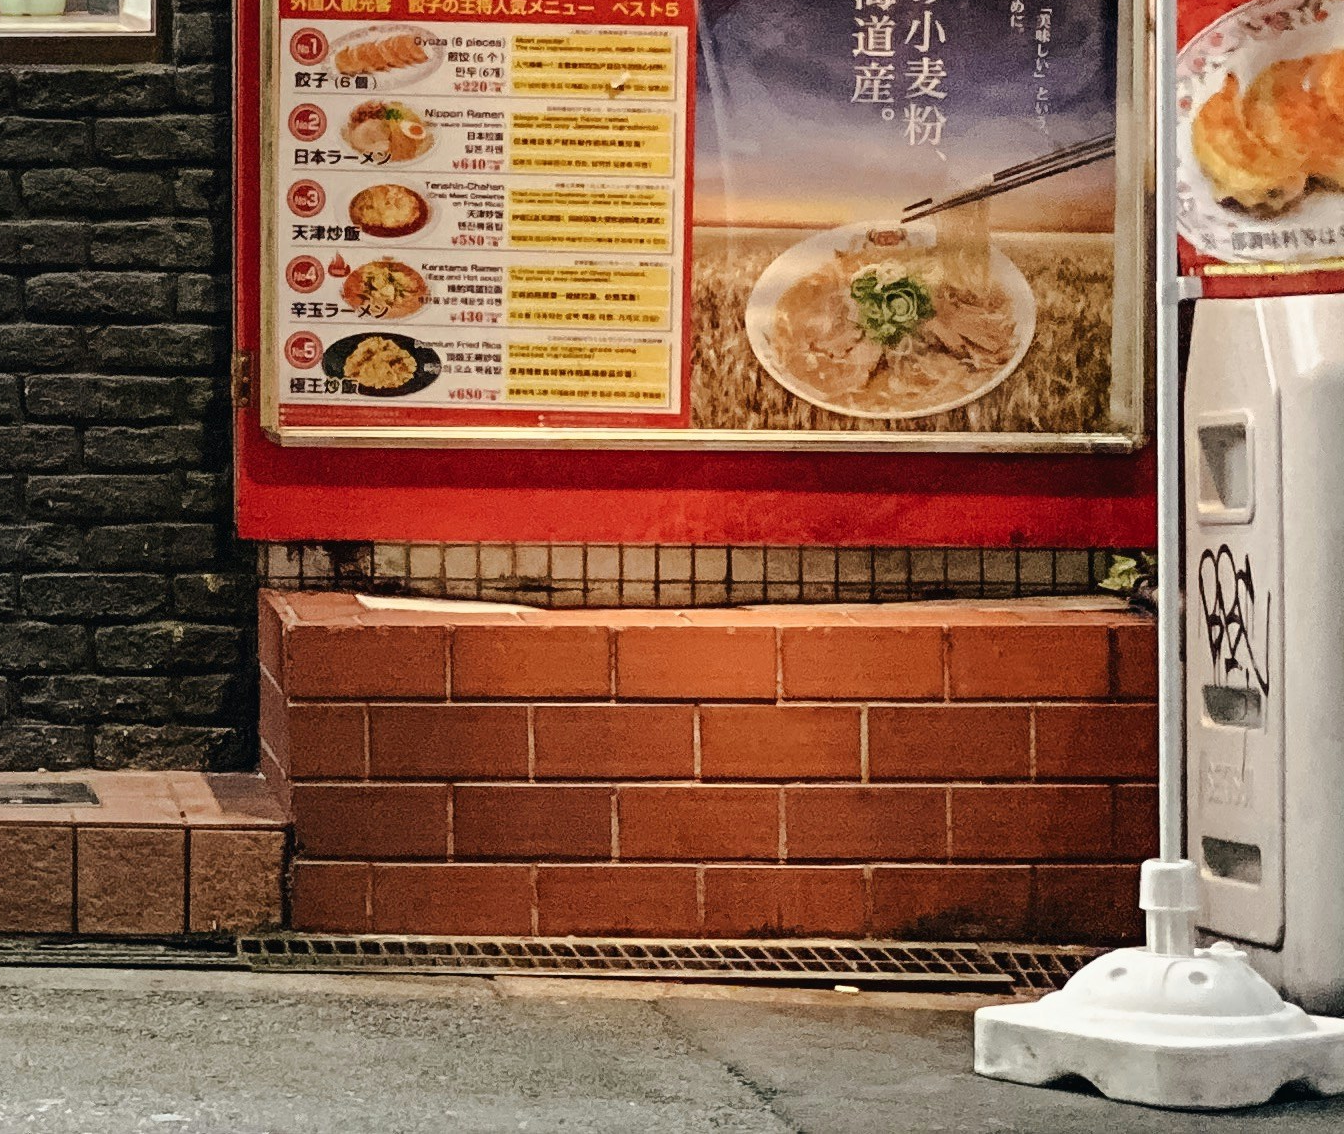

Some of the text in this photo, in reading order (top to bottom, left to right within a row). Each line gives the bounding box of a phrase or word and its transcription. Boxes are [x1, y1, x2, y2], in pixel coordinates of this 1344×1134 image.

[612, 1, 679, 17] ベスト5
[414, 37, 448, 47] Gyoza
[295, 71, 328, 89] 餃子
[454, 81, 488, 93] ¥220
[425, 108, 505, 120] Nippon Ramen
[295, 149, 392, 165] 日本ラーメン
[292, 224, 361, 241] 天津炒飯
[290, 302, 389, 318] 辛玉ラーメン
[290, 378, 360, 395] 極王炒飯
